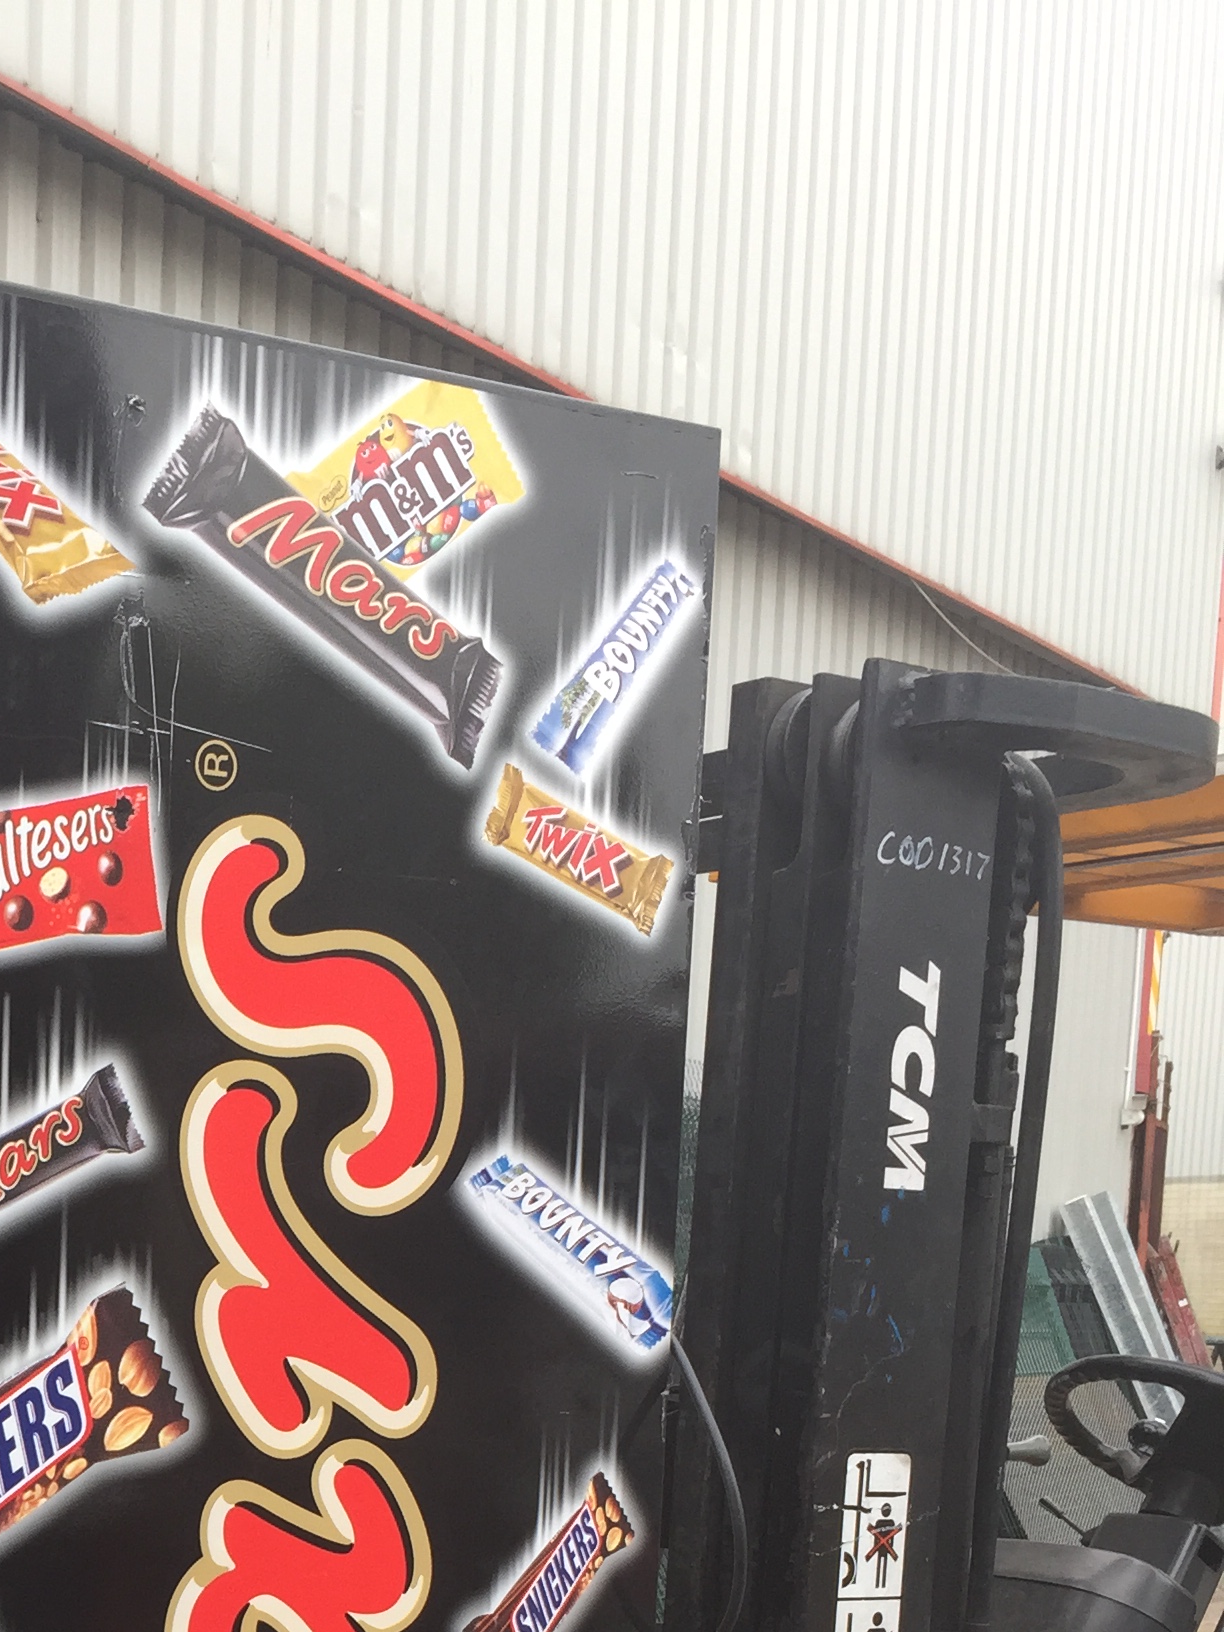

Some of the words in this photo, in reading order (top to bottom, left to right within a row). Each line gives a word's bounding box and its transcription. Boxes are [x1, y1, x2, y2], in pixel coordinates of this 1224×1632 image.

[228, 497, 459, 660] Mars
[583, 574, 676, 703] BOUNTY
[883, 959, 941, 1191] TCM
[502, 1170, 636, 1281] BOUNTY
